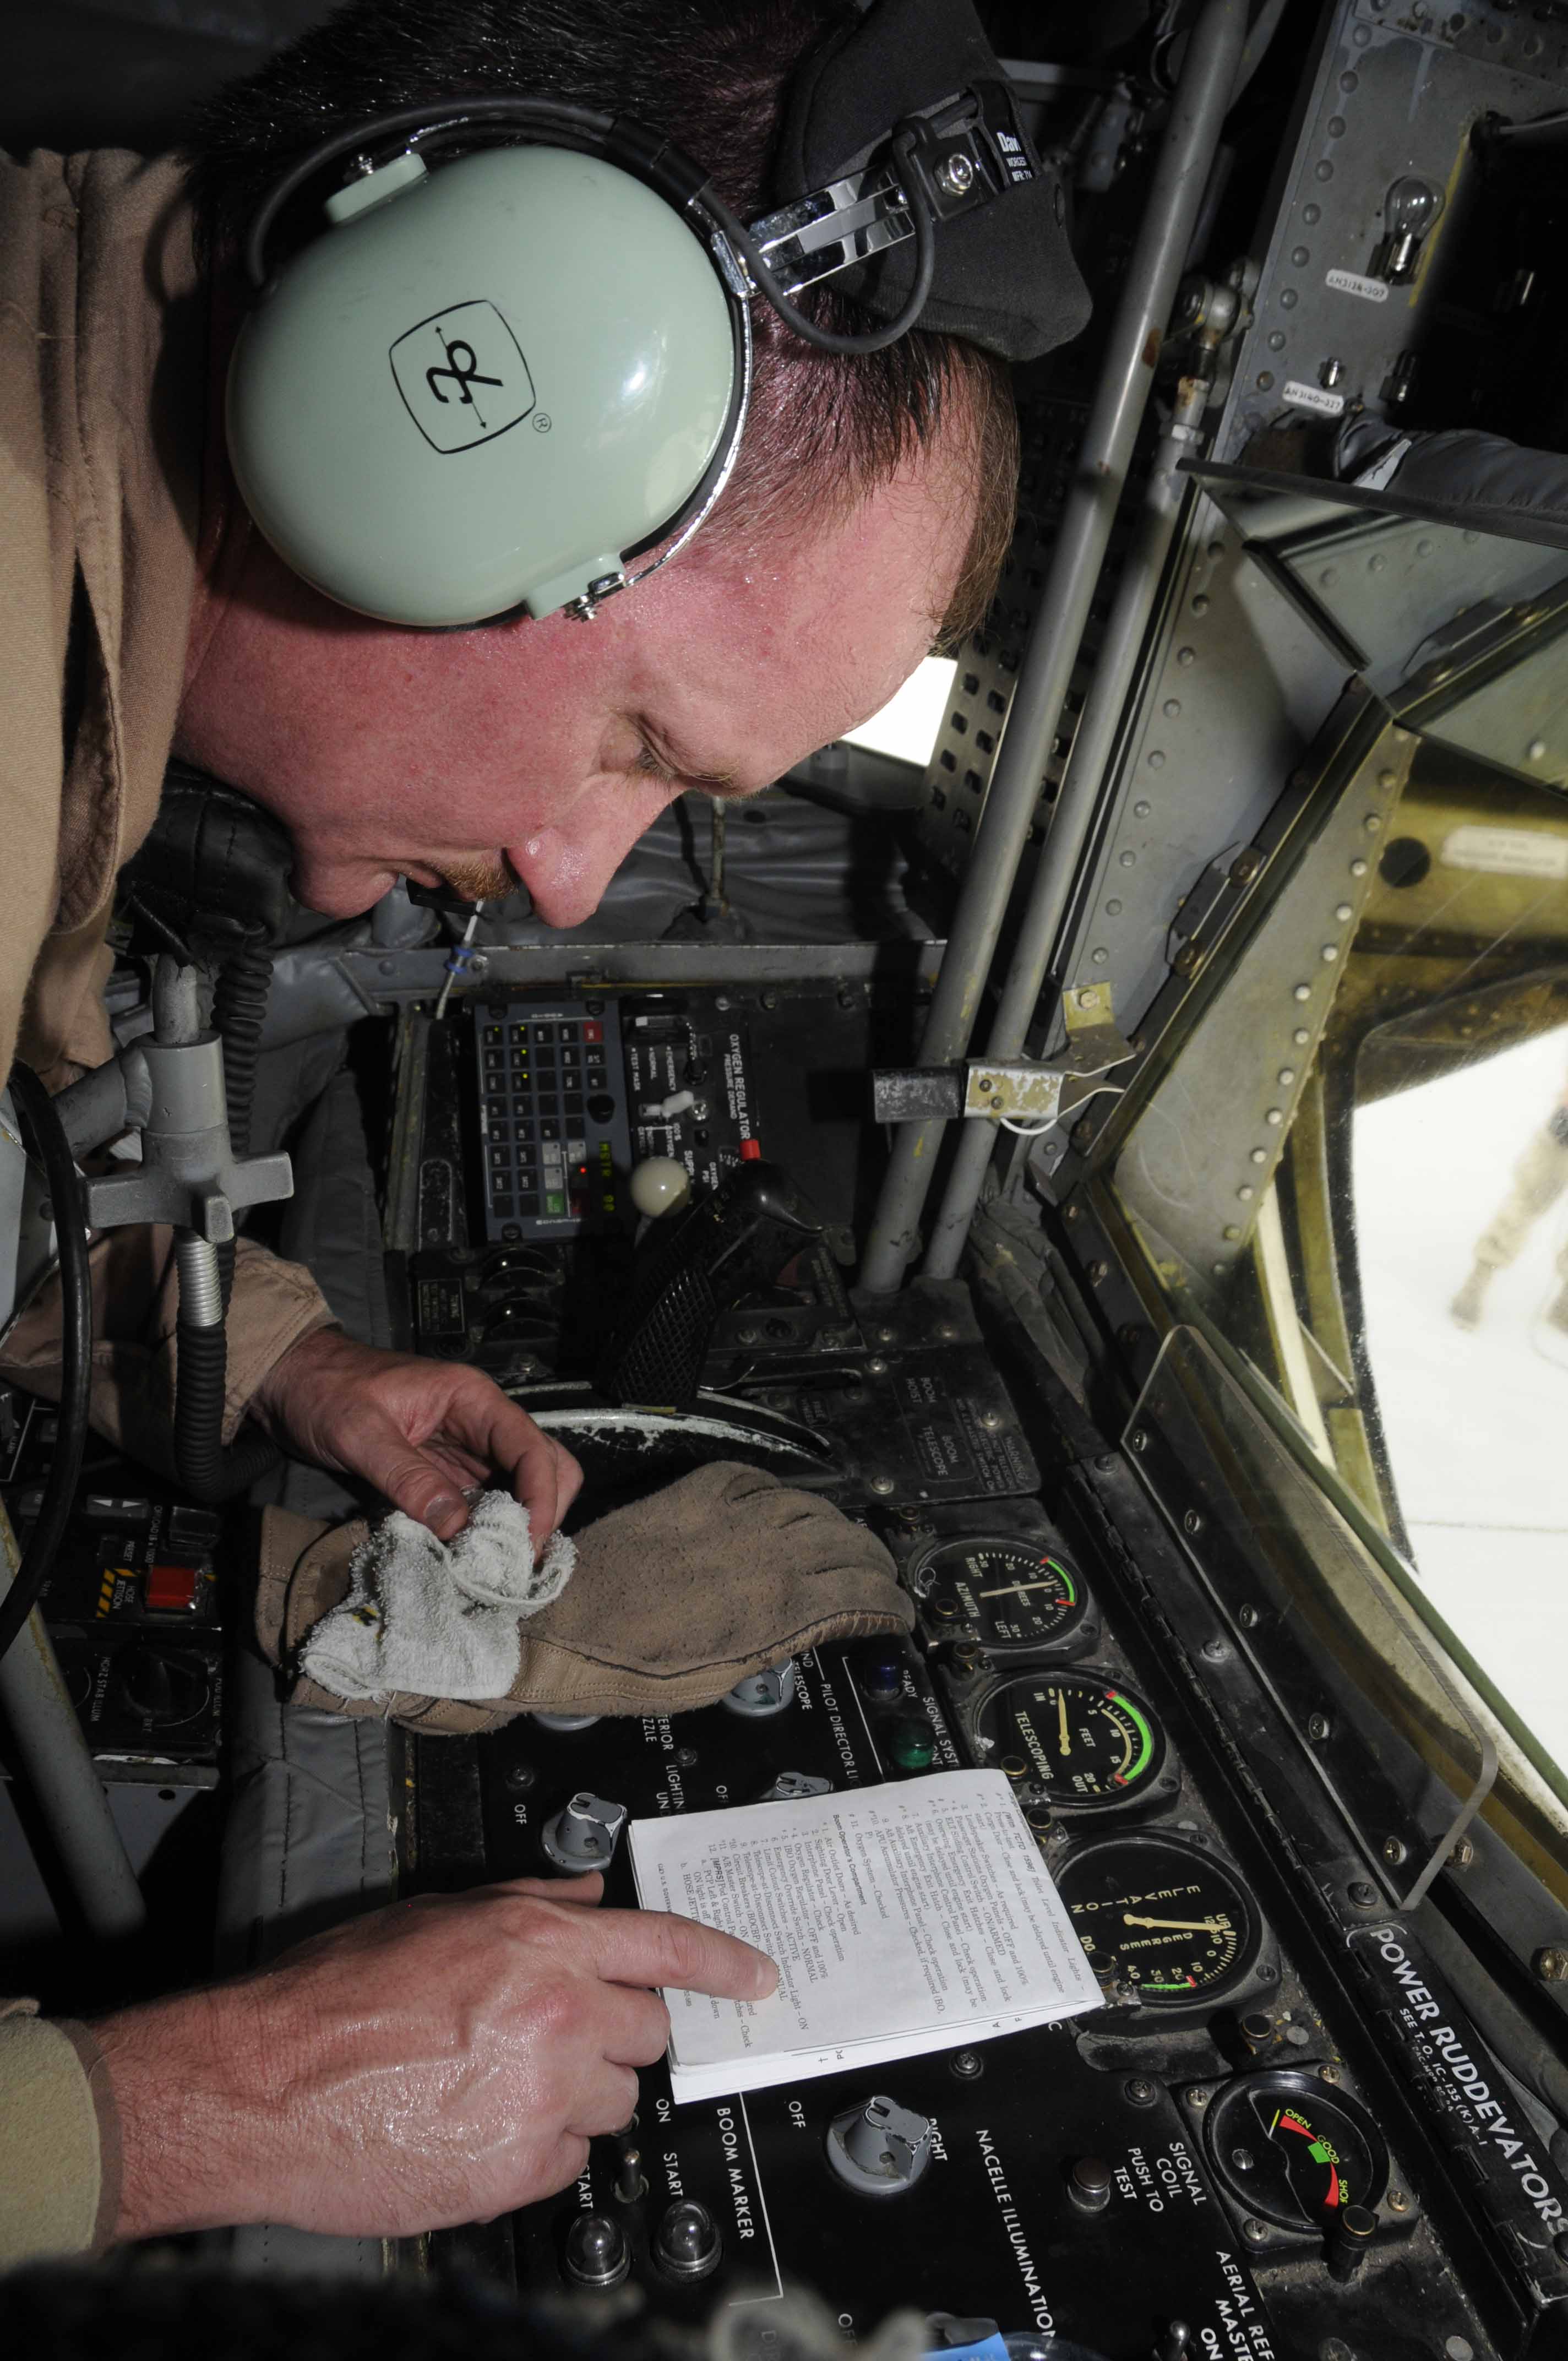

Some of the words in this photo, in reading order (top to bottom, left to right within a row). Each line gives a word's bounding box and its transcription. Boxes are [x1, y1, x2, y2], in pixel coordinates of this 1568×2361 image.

[648, 1051, 657, 1080] NORMAL
[729, 1033, 743, 1074] OXYGEN
[665, 1051, 677, 1091] EMERGENCY
[723, 1053, 733, 1089] PRESSURE
[727, 1091, 737, 1119] DEMAND
[734, 1077, 752, 1139] REGULATOR
[906, 1378, 923, 1404] HOIST
[920, 1377, 937, 1404] BOOM
[922, 1426, 949, 1477] TELESCOPE
[942, 1435, 959, 1464] BOOM
[965, 1557, 983, 1577] RIGHT
[112, 1579, 127, 1610] JETTISON
[126, 1585, 137, 1604] HOSE
[954, 1581, 981, 1618] AZIMUTH
[994, 1620, 1011, 1639] LEFT
[97, 1656, 111, 1677] HORZ
[95, 1679, 108, 1698] STAB
[820, 1683, 839, 1712] PILOT
[1033, 1692, 1047, 1701] IN
[922, 1696, 947, 1736] SIGNAL
[829, 1716, 856, 1767] DIRECTOR
[1014, 1711, 1055, 1780] TELESCOPING
[1079, 1727, 1096, 1747] FEET
[1109, 1728, 1121, 1738] 10
[1109, 1755, 1122, 1764] 15
[1072, 1775, 1088, 1792] OUT
[1084, 1772, 1097, 1783] 20
[514, 1804, 527, 1824] OFF
[812, 1838, 830, 1868] Sighting
[824, 1836, 834, 1847] Air
[731, 1853, 745, 1875] Circuit
[763, 1848, 775, 1865] Limit
[802, 1841, 822, 1878] Interphone
[827, 1849, 841, 1870] Outlet
[832, 1814, 843, 1830] Boom
[846, 1863, 868, 1906] Compartment
[723, 1868, 739, 1892] Master
[767, 1867, 782, 1891] Cutout
[786, 1859, 802, 1885] Oxygen
[823, 1868, 835, 1885] Door
[835, 1872, 848, 1892] Doors
[736, 1876, 754, 1908] Breakers
[814, 1879, 828, 1898] Panel
[827, 1886, 841, 1905] Lever
[1070, 1885, 1201, 1913] ELEVATION
[729, 1893, 745, 1918] Switch
[771, 1846, 791, 1883] Emergency
[782, 1884, 800, 1916] Override
[791, 1916, 807, 1940] Switch
[800, 1947, 819, 1983] NORMAL
[774, 1892, 791, 1924] Switches
[793, 1885, 813, 1920] Regulator
[843, 1900, 853, 1908] As
[822, 1905, 837, 1927] Check
[835, 1912, 850, 1932] Open
[846, 1910, 861, 1935] desired
[738, 1925, 749, 1938] ON
[772, 1930, 788, 1955] Switch
[806, 1927, 819, 1944] OFF
[827, 1928, 846, 1961] operation
[1119, 1932, 1193, 1951] DEGREES
[784, 1932, 801, 1961] ACTIVE
[811, 1945, 823, 1959] and
[779, 1956, 797, 1988] Indicator
[815, 1960, 829, 1978] 100%
[1127, 1965, 1141, 1979] 40
[788, 1990, 803, 2010] Light
[797, 2017, 809, 2030] ON
[1399, 2008, 1418, 2028] SEE
[1370, 1928, 1440, 2021] POWER
[1429, 2026, 1568, 2236] RUDDEVATORS
[656, 2098, 672, 2123] ON
[788, 2101, 806, 2128] OFF
[1284, 2108, 1311, 2130] OPEN
[716, 2108, 739, 2161] BOOM
[1316, 2135, 1340, 2164] GOOD
[662, 2152, 684, 2196] START
[976, 2130, 1012, 2203] NACELLE
[1128, 2147, 1154, 2185] PUSH
[1145, 2190, 1164, 2212] TO
[1156, 2158, 1183, 2198] COIL
[1168, 2142, 1207, 2206] SIGNAL
[1114, 2166, 1137, 2199] TEST
[727, 2168, 755, 2239] MARKER
[1216, 2251, 1255, 2318] AERIAL
[1200, 2328, 1223, 2360] ON
